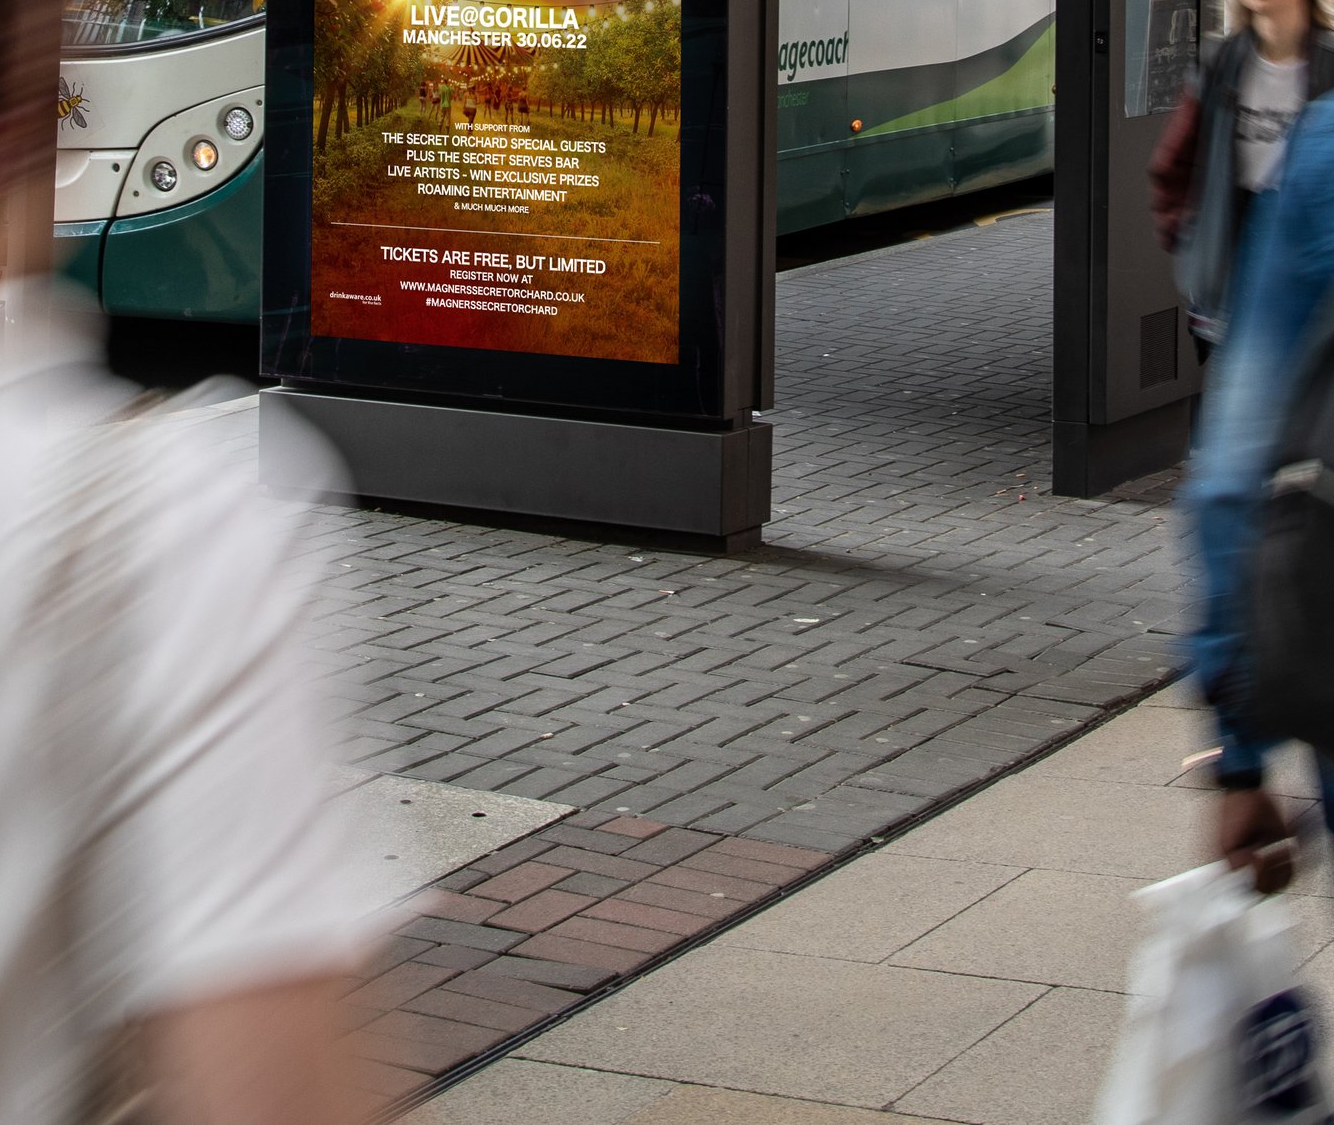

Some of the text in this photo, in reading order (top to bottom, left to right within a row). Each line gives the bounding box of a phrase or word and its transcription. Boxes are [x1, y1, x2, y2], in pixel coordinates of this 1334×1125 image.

[410, 5, 579, 29] LIVE@GORILLA
[403, 29, 587, 49] MANCHESTER 30.06.22
[778, 30, 849, 82] agecoach
[454, 123, 530, 133] WITH SUPPORT FROM
[382, 132, 606, 153] THE SECRET ORCHARD SPECIAL GUESTS
[406, 150, 580, 169] PLUS THE SECRET SERVES BAR
[387, 165, 411, 177] LIVE
[413, 167, 460, 180] ARTISTS
[469, 169, 492, 182] WIN
[494, 171, 557, 185] EXCLUSIVE
[559, 174, 600, 187] PRIZES
[417, 183, 567, 202] ROAMING ENTERTAINMENT
[454, 202, 530, 214] & MUCH MUCH MORE
[380, 246, 606, 274] TICKETS ARE FREE, BUT LIMITED
[450, 270, 533, 284] REGISTER NOW AT
[329, 291, 382, 302] drinkaware.co.uk
[400, 281, 585, 303] WWW.MAGNERSSECRETORCHARD.CO.UK
[425, 297, 558, 315] #MAGNERSSECRETORCHARD
